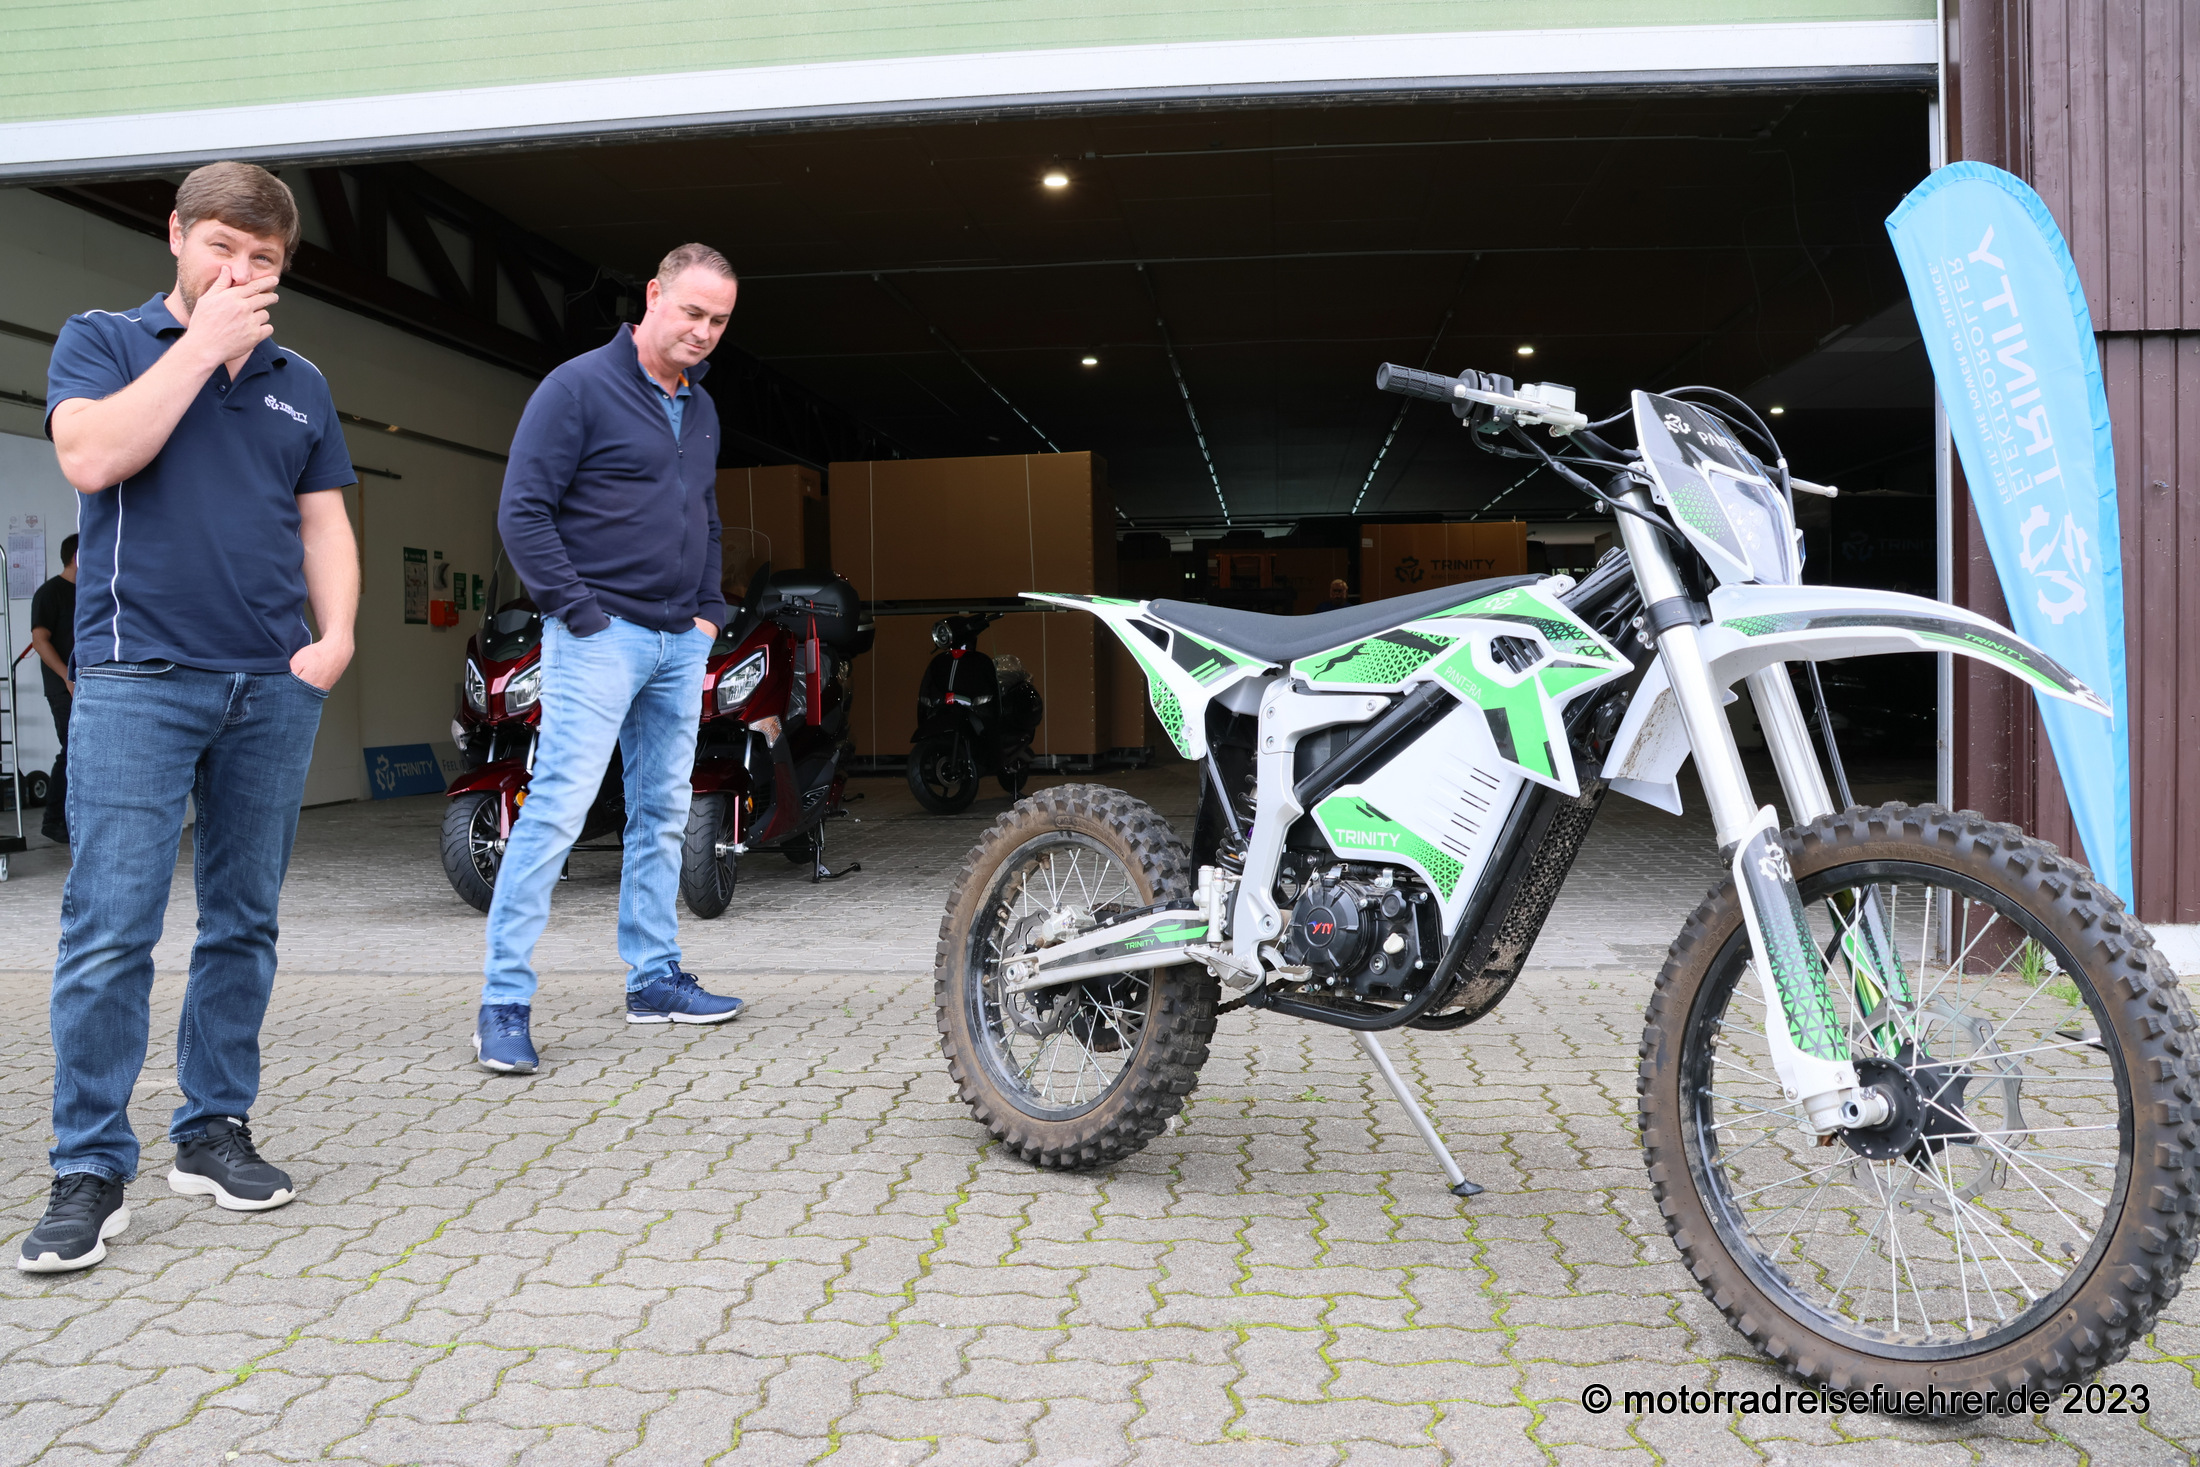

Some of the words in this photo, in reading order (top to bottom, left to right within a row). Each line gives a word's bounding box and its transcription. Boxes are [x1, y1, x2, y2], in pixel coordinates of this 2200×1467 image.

[1430, 559, 1496, 571] TRINITY
[1964, 633, 2031, 661] TRINITY
[394, 761, 433, 777] TRINITY
[1335, 829, 1401, 847] TRINITY
[1124, 938, 1155, 950] TRINITY
